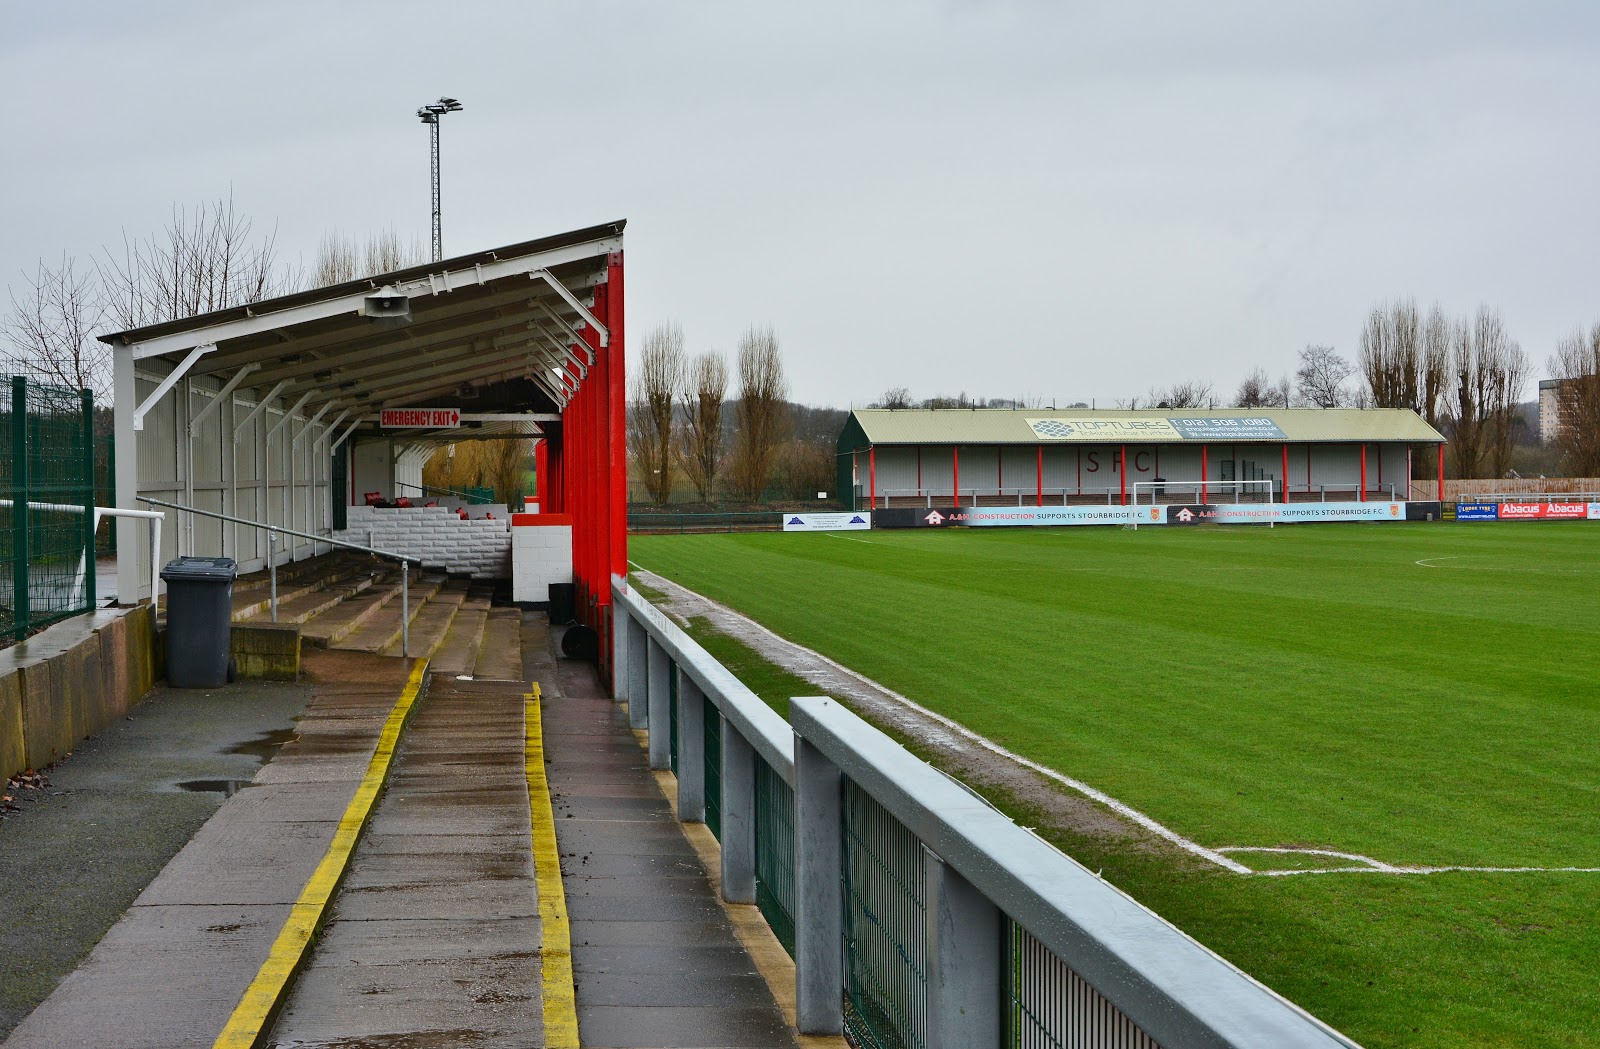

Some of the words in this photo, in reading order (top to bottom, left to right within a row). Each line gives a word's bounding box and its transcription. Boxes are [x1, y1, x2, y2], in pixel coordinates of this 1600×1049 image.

[382, 411, 431, 425] EMERGENCY
[433, 411, 450, 425] EXIT
[1070, 421, 1170, 429] TOPTUBES
[1321, 508, 1371, 516] STOURBRIDGE
[1502, 504, 1540, 513] Abacus
[1547, 503, 1584, 513] Abacus
